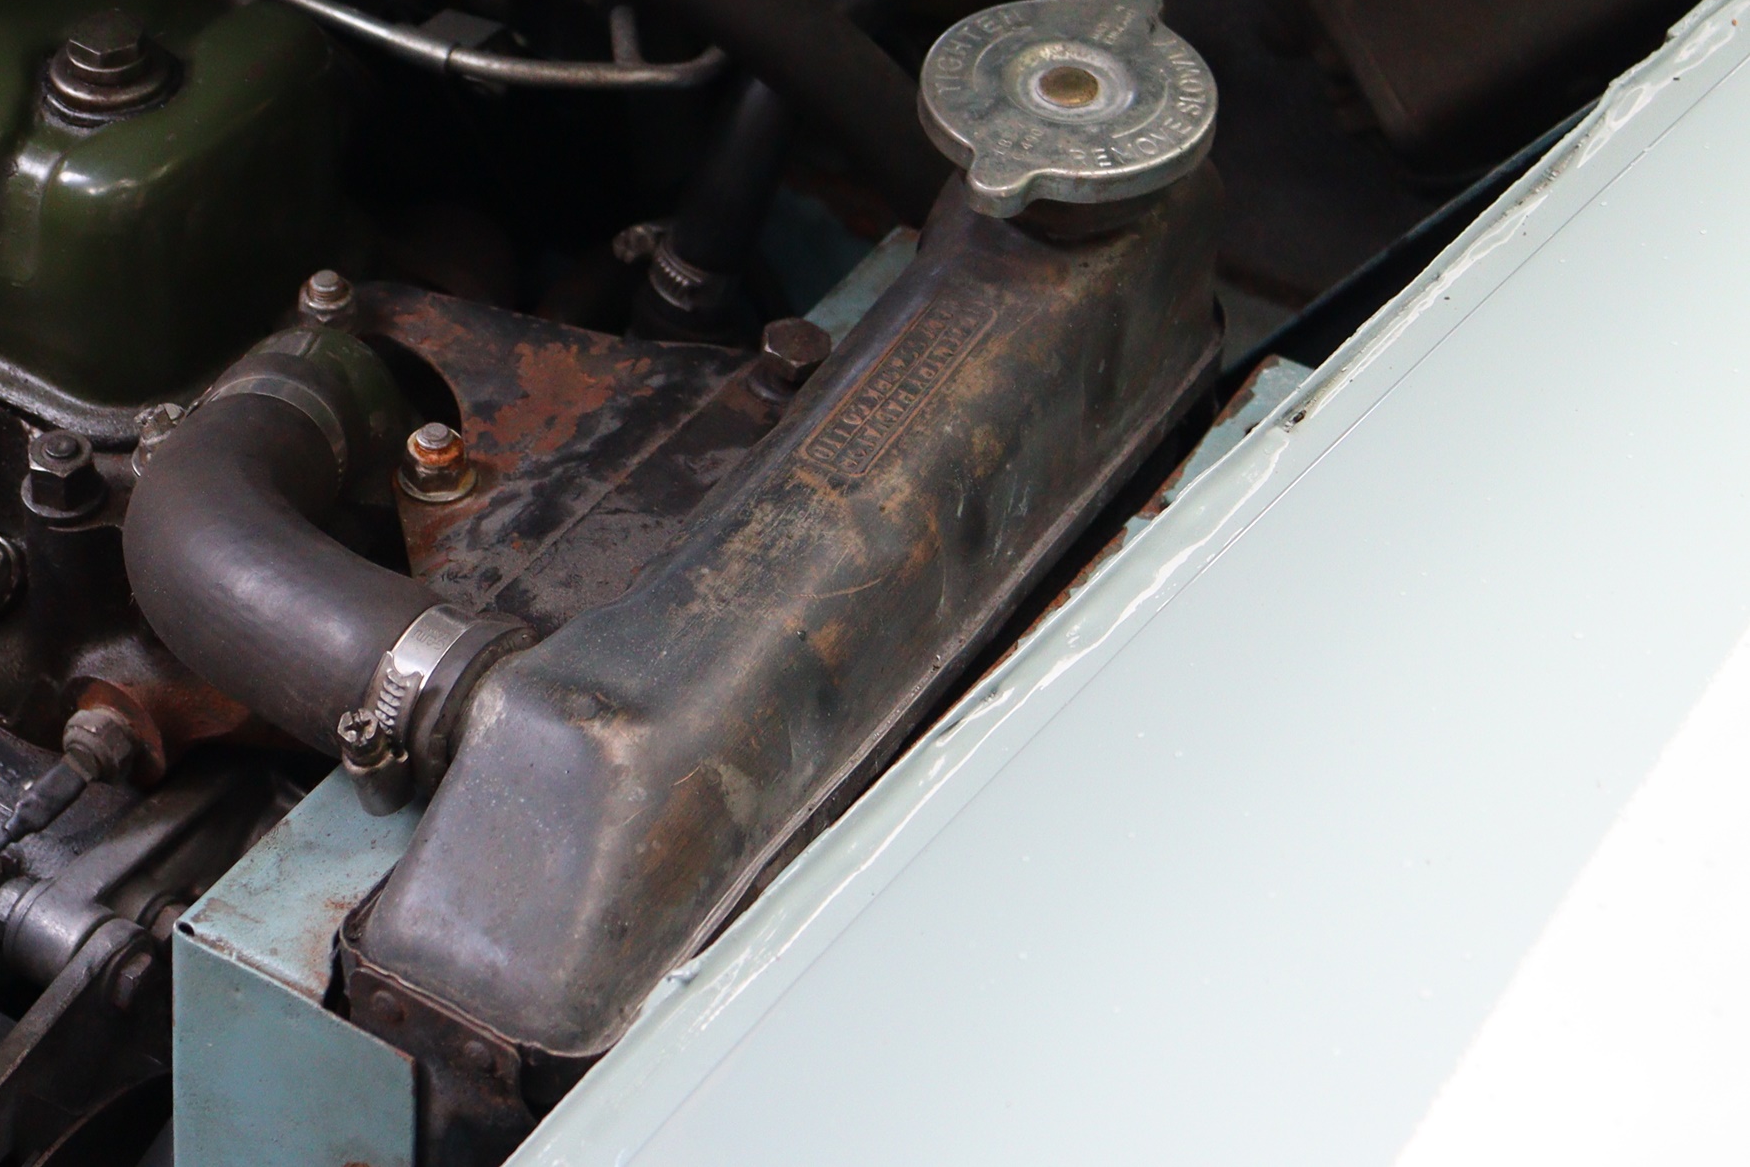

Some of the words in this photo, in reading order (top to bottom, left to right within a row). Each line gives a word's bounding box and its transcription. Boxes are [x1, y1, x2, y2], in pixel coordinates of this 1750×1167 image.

[937, 9, 1024, 95] TIGHTEN
[1068, 120, 1193, 168] REMOVE
[1152, 37, 1208, 118] SLOWLY
